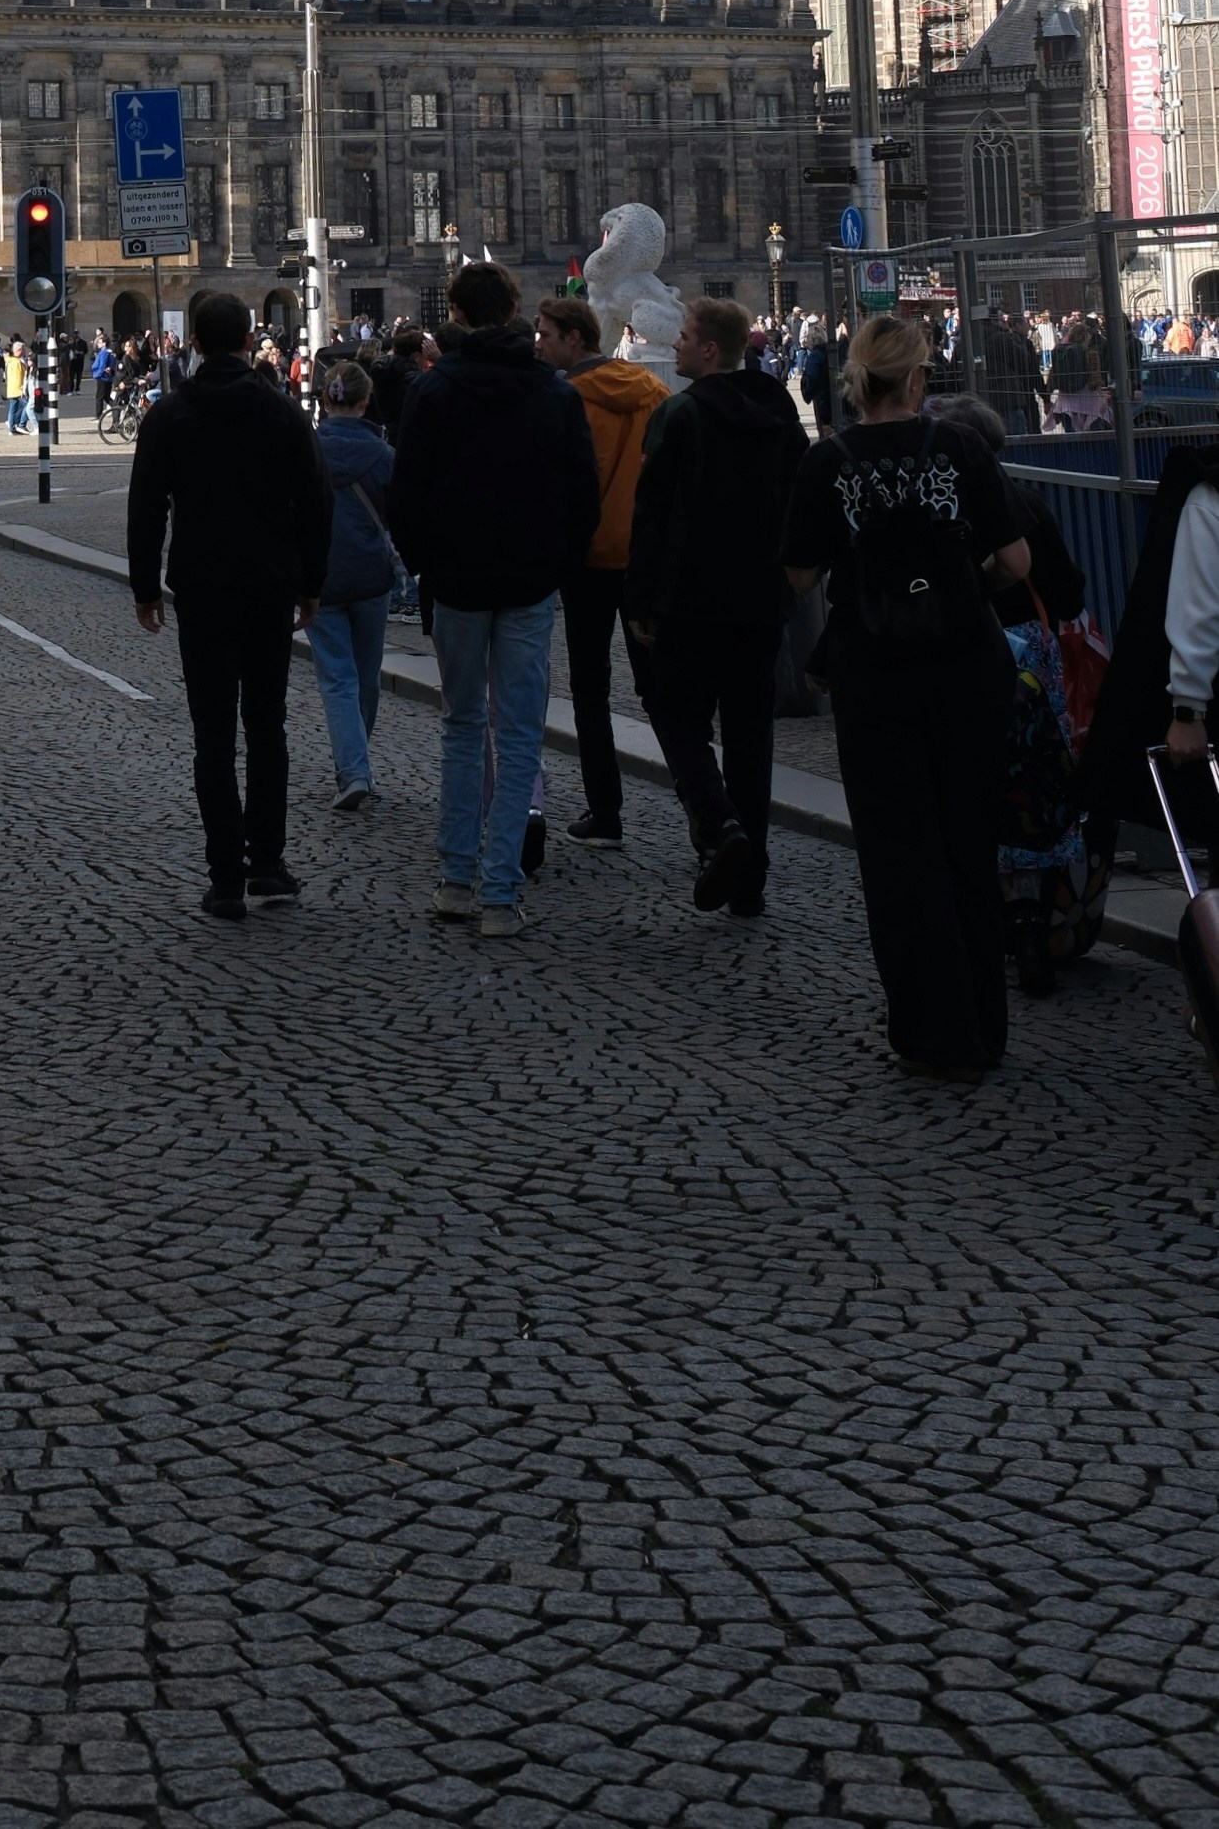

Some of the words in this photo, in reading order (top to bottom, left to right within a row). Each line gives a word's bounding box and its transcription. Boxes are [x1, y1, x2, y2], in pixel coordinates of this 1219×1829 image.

[1130, 55, 1157, 131] PHOTO
[1135, 146, 1161, 214] 2026
[126, 190, 179, 201] uitgezonderd
[123, 205, 145, 213] laden
[173, 214, 179, 222] h
